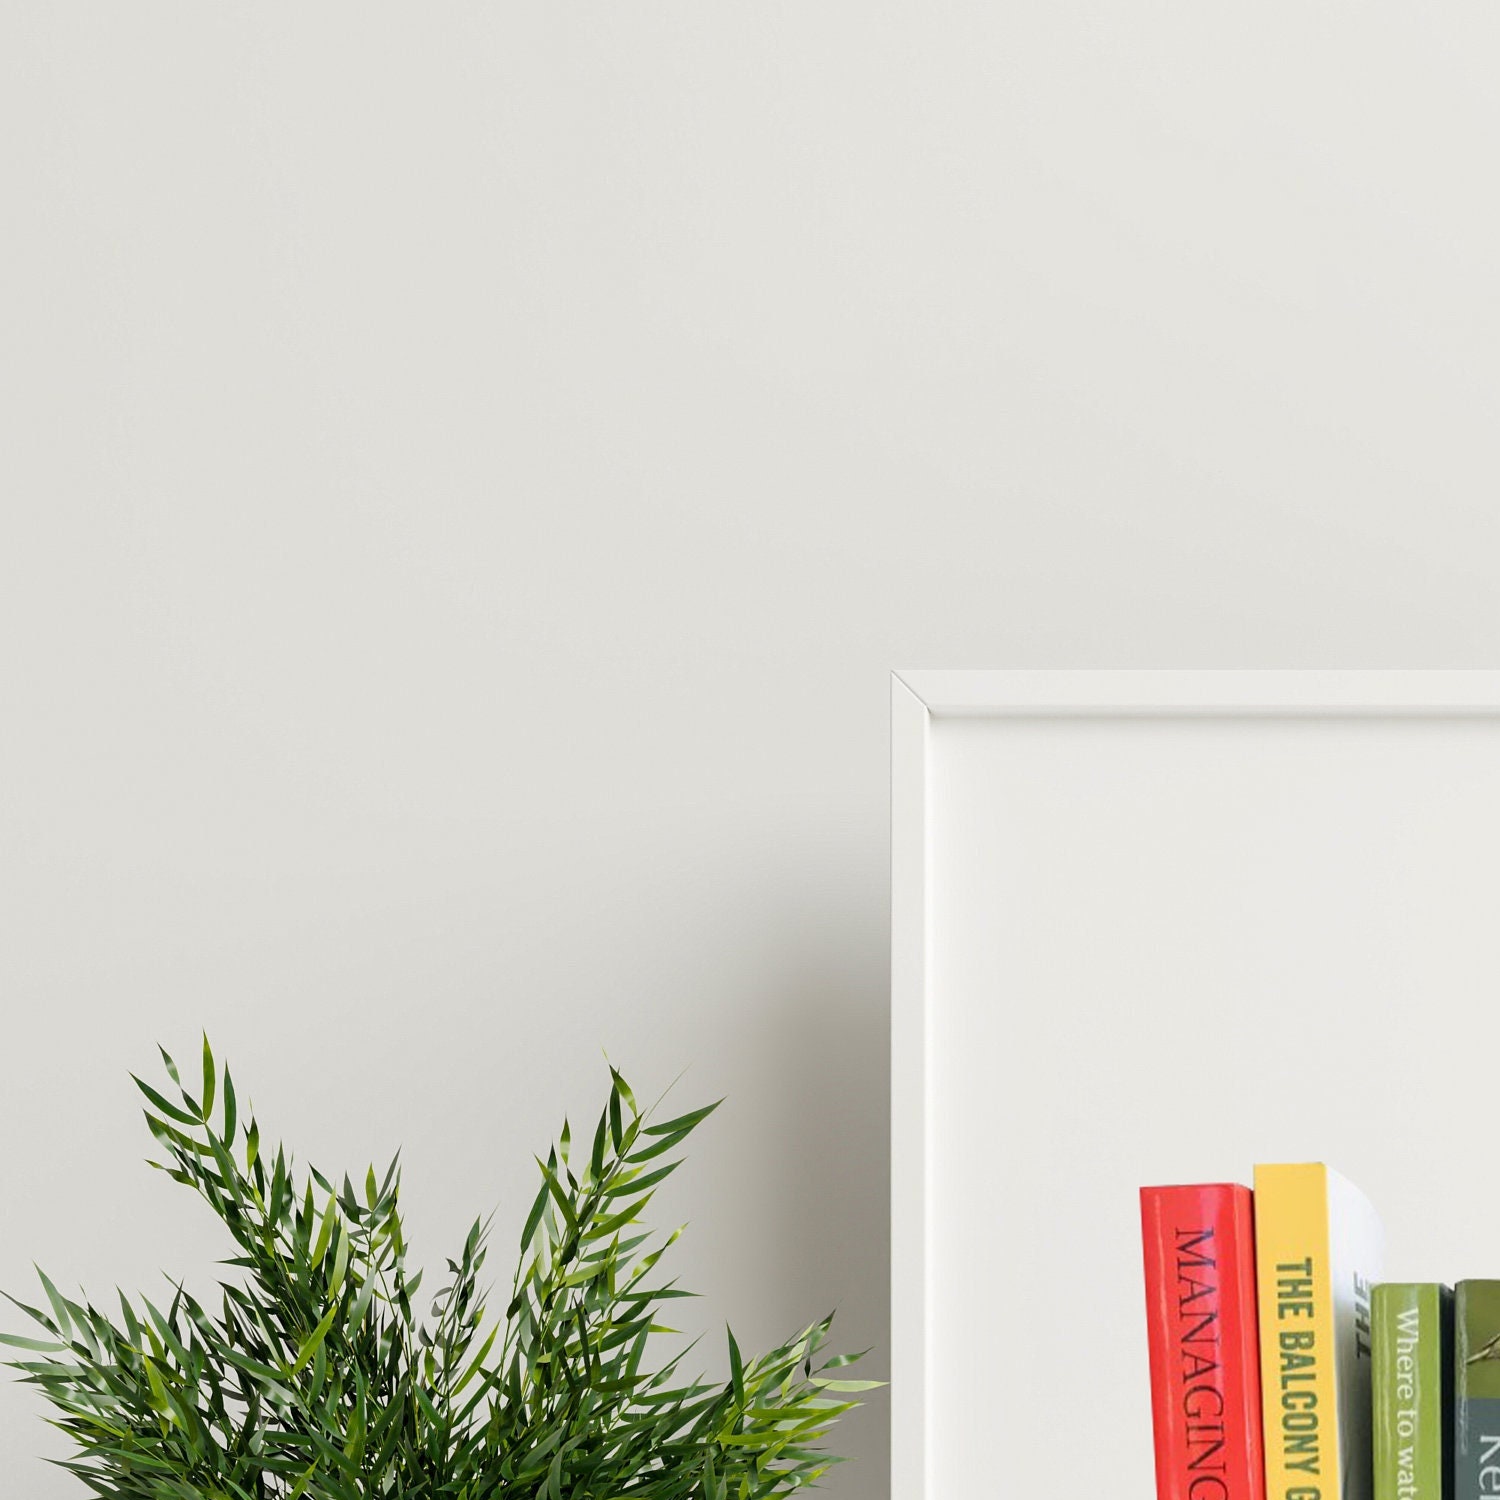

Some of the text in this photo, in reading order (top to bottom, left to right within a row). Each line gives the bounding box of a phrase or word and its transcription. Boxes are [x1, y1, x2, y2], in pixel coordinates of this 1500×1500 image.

[1276, 1257, 1314, 1320] THE
[1396, 1306, 1420, 1400] Where
[1277, 1331, 1320, 1475] BALCONY
[1397, 1408, 1415, 1438] to
